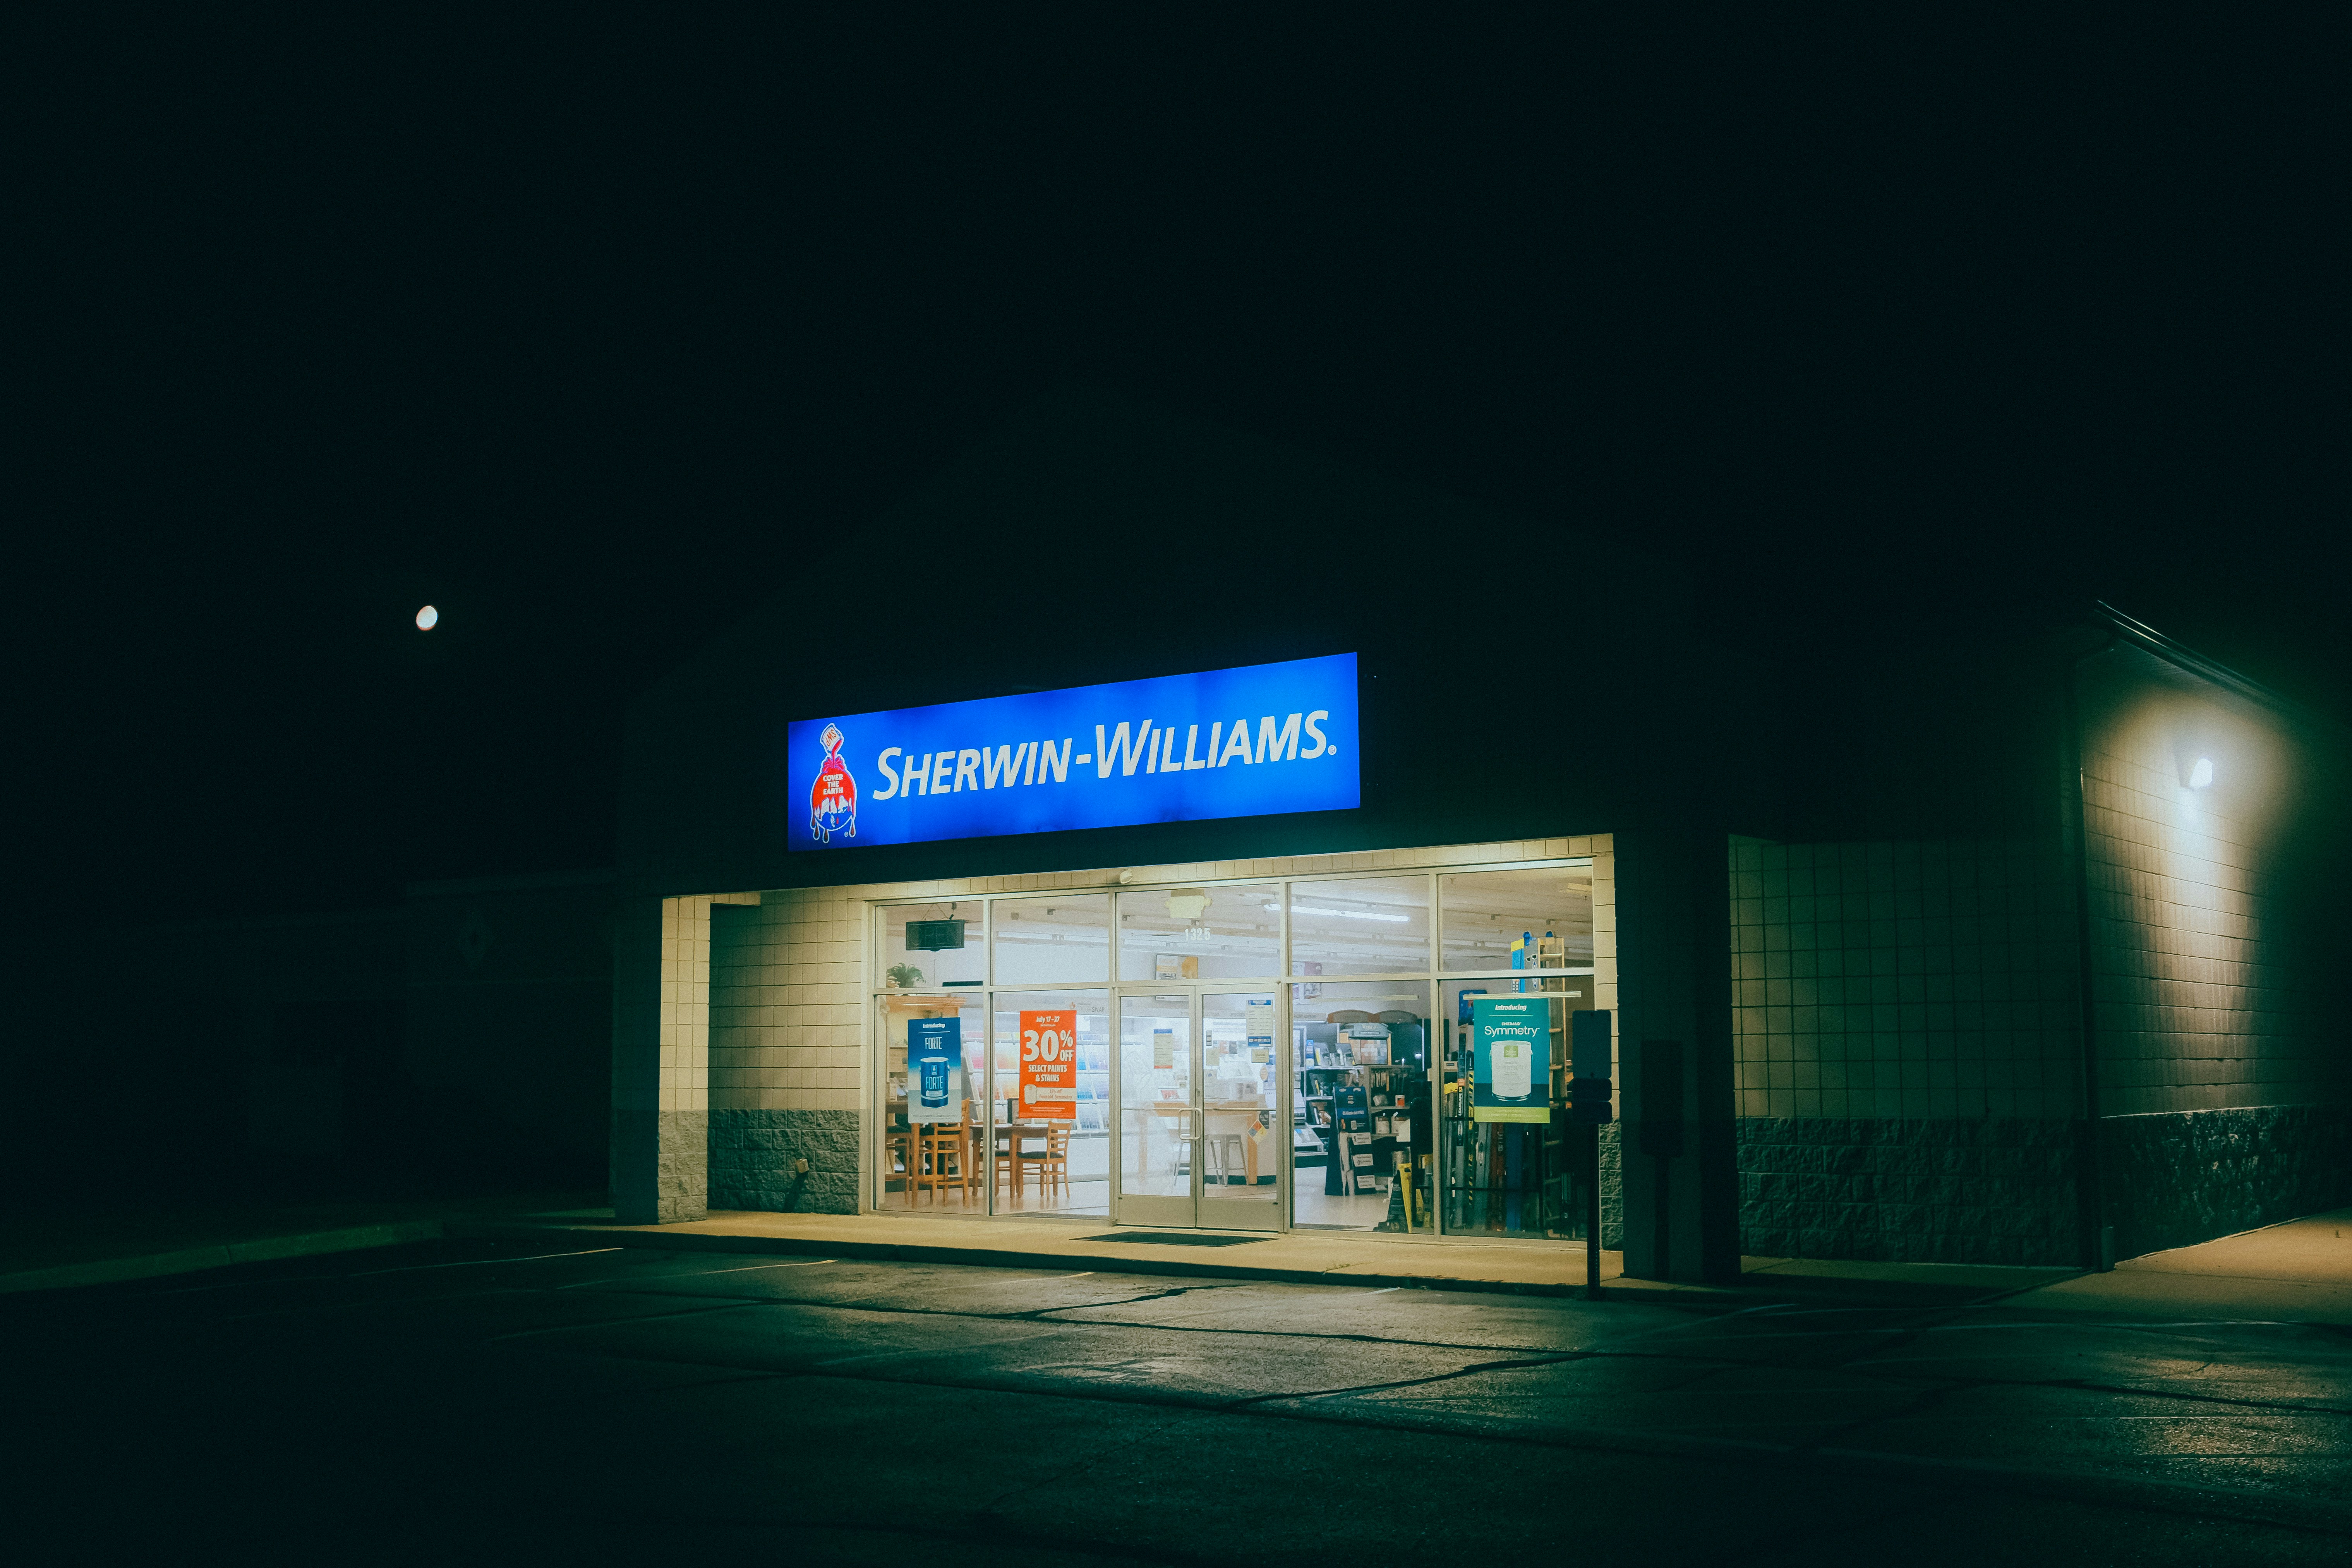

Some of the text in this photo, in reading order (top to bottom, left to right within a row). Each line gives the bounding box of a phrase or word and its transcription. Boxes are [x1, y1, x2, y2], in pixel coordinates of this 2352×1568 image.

[823, 774, 843, 782] COVER
[823, 787, 843, 795] EARTH
[1184, 927, 1211, 942] 1325
[1036, 1016, 1045, 1024] July
[925, 1037, 942, 1050] FORTE
[926, 1076, 943, 1089] FORTE
